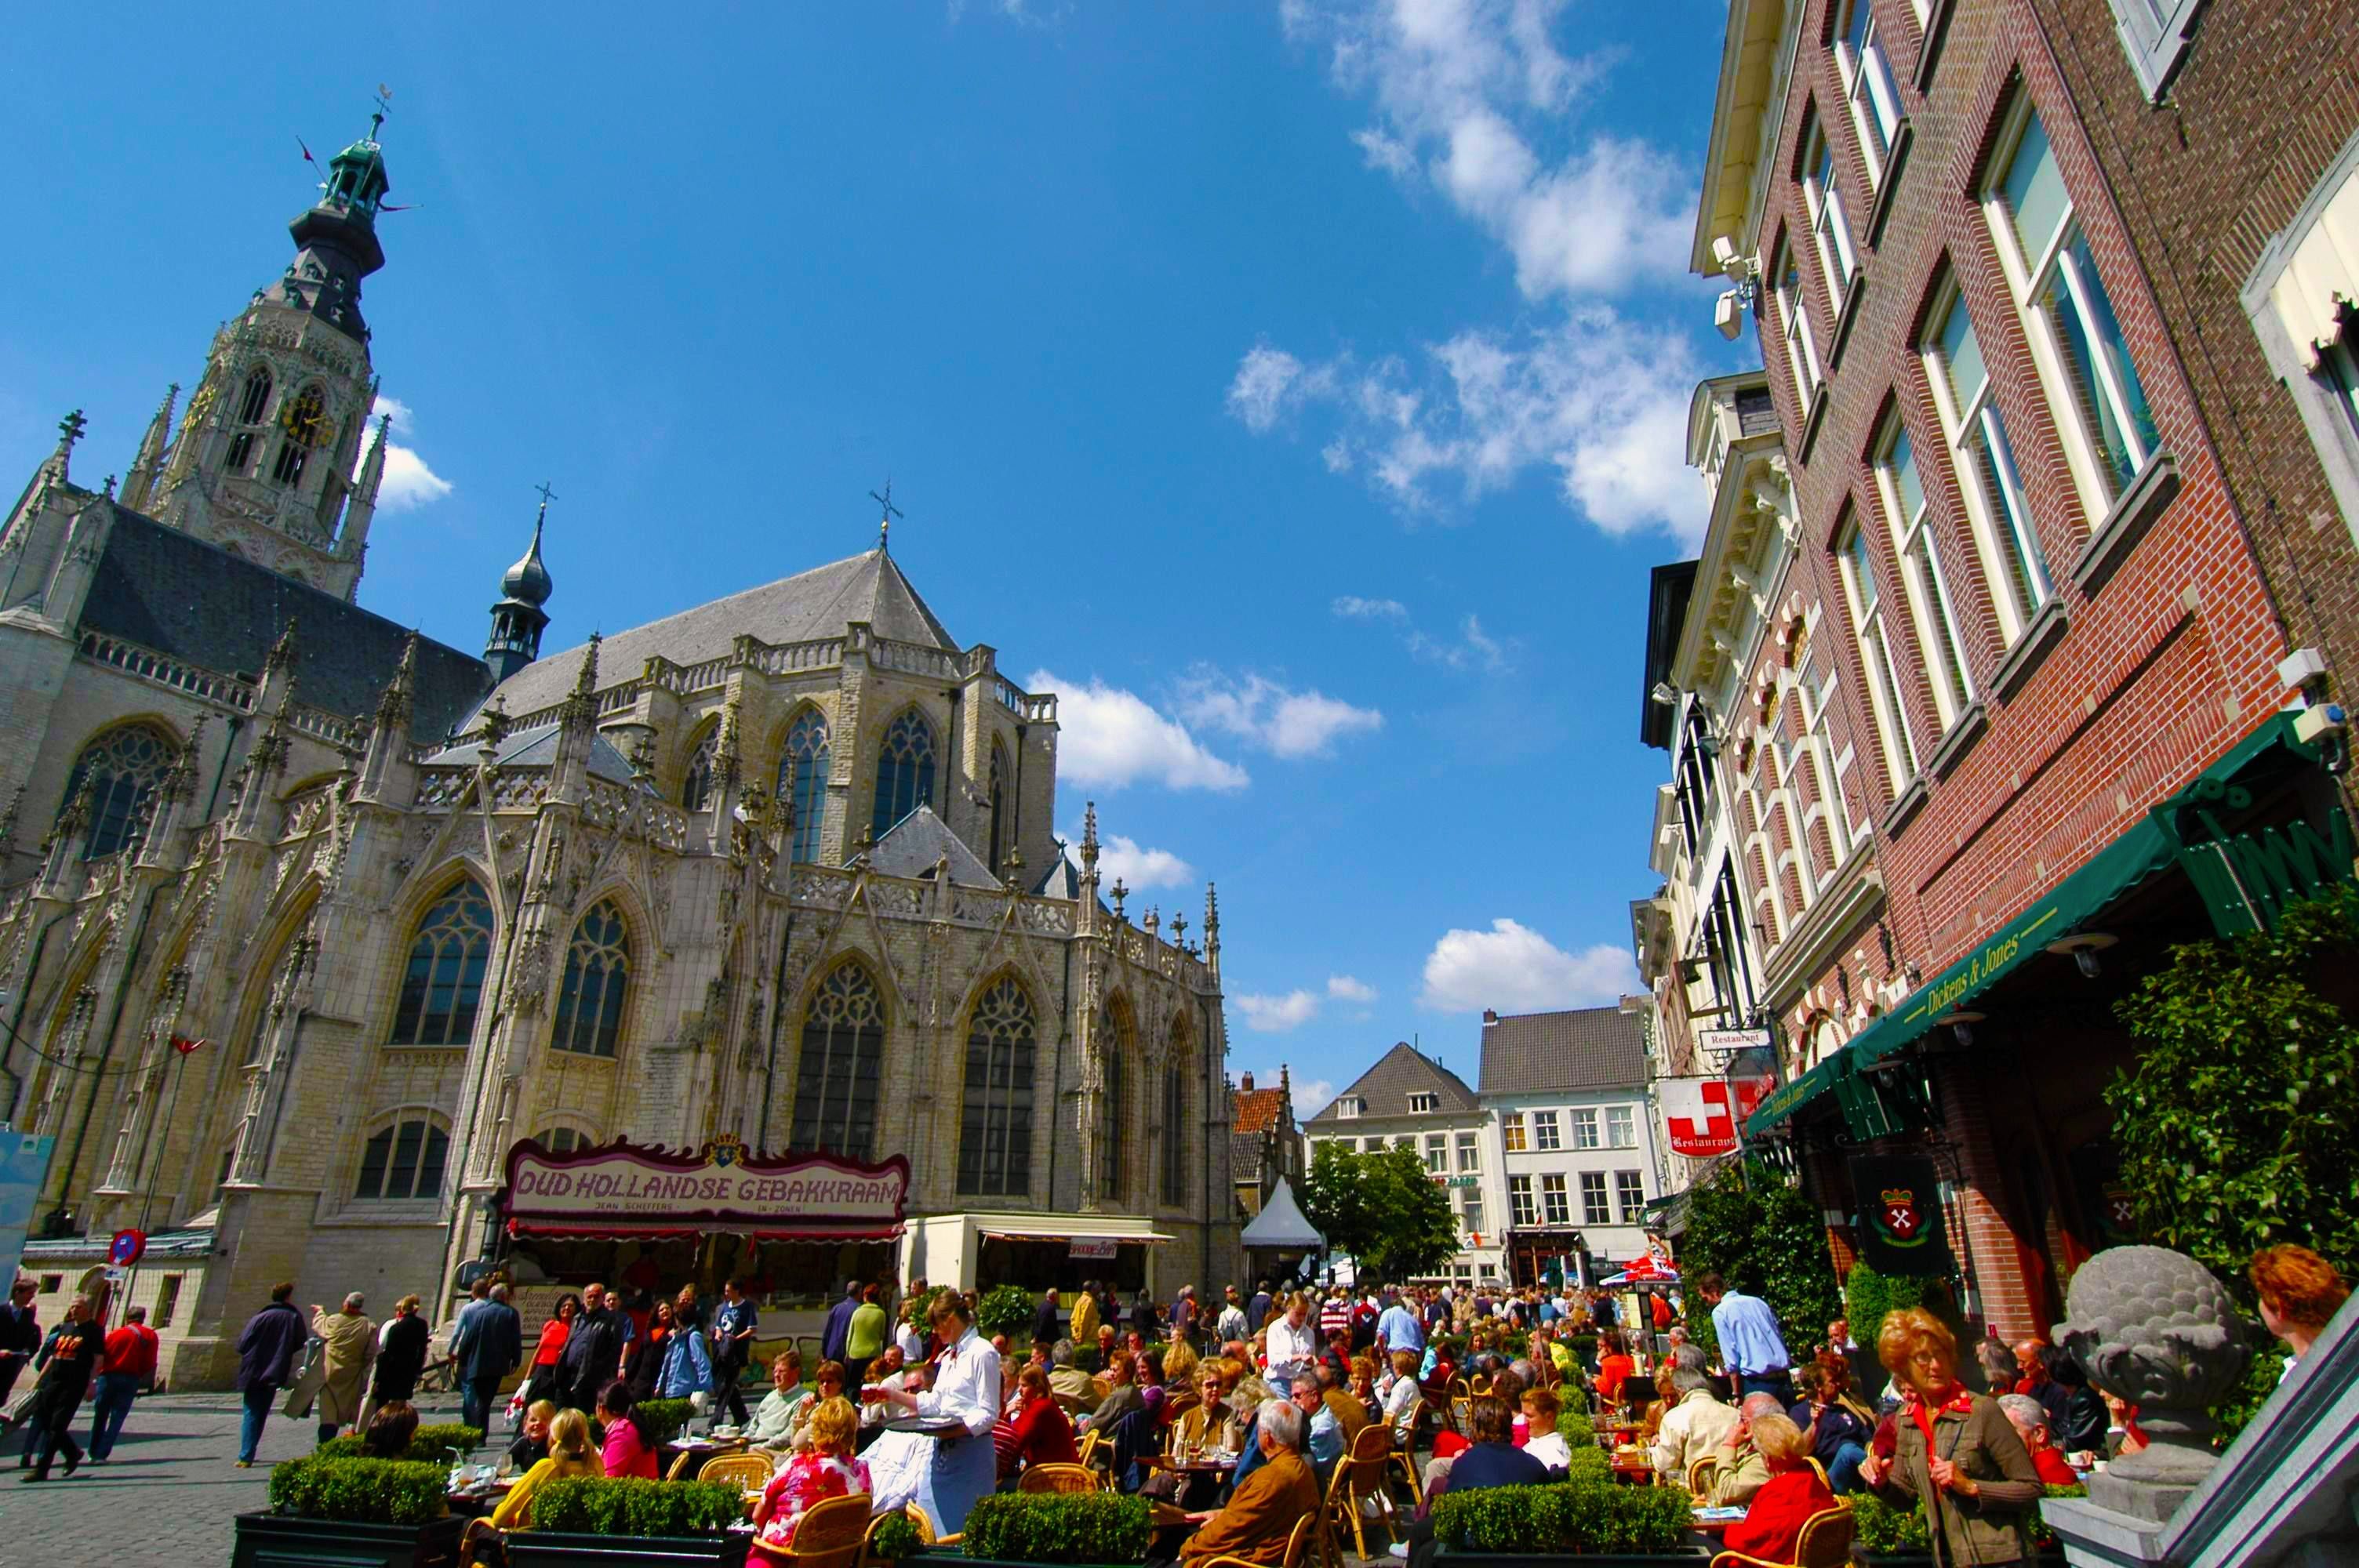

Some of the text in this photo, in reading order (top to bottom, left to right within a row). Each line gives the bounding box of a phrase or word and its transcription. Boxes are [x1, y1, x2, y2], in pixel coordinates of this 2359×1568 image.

[1928, 934, 2019, 1016] Dickens & Jones
[1711, 1034, 1760, 1044] Restaurant
[1672, 1136, 1735, 1148] Restaurant
[516, 1171, 900, 1203] OUD HOLLANDSE GEBAKKRAAM
